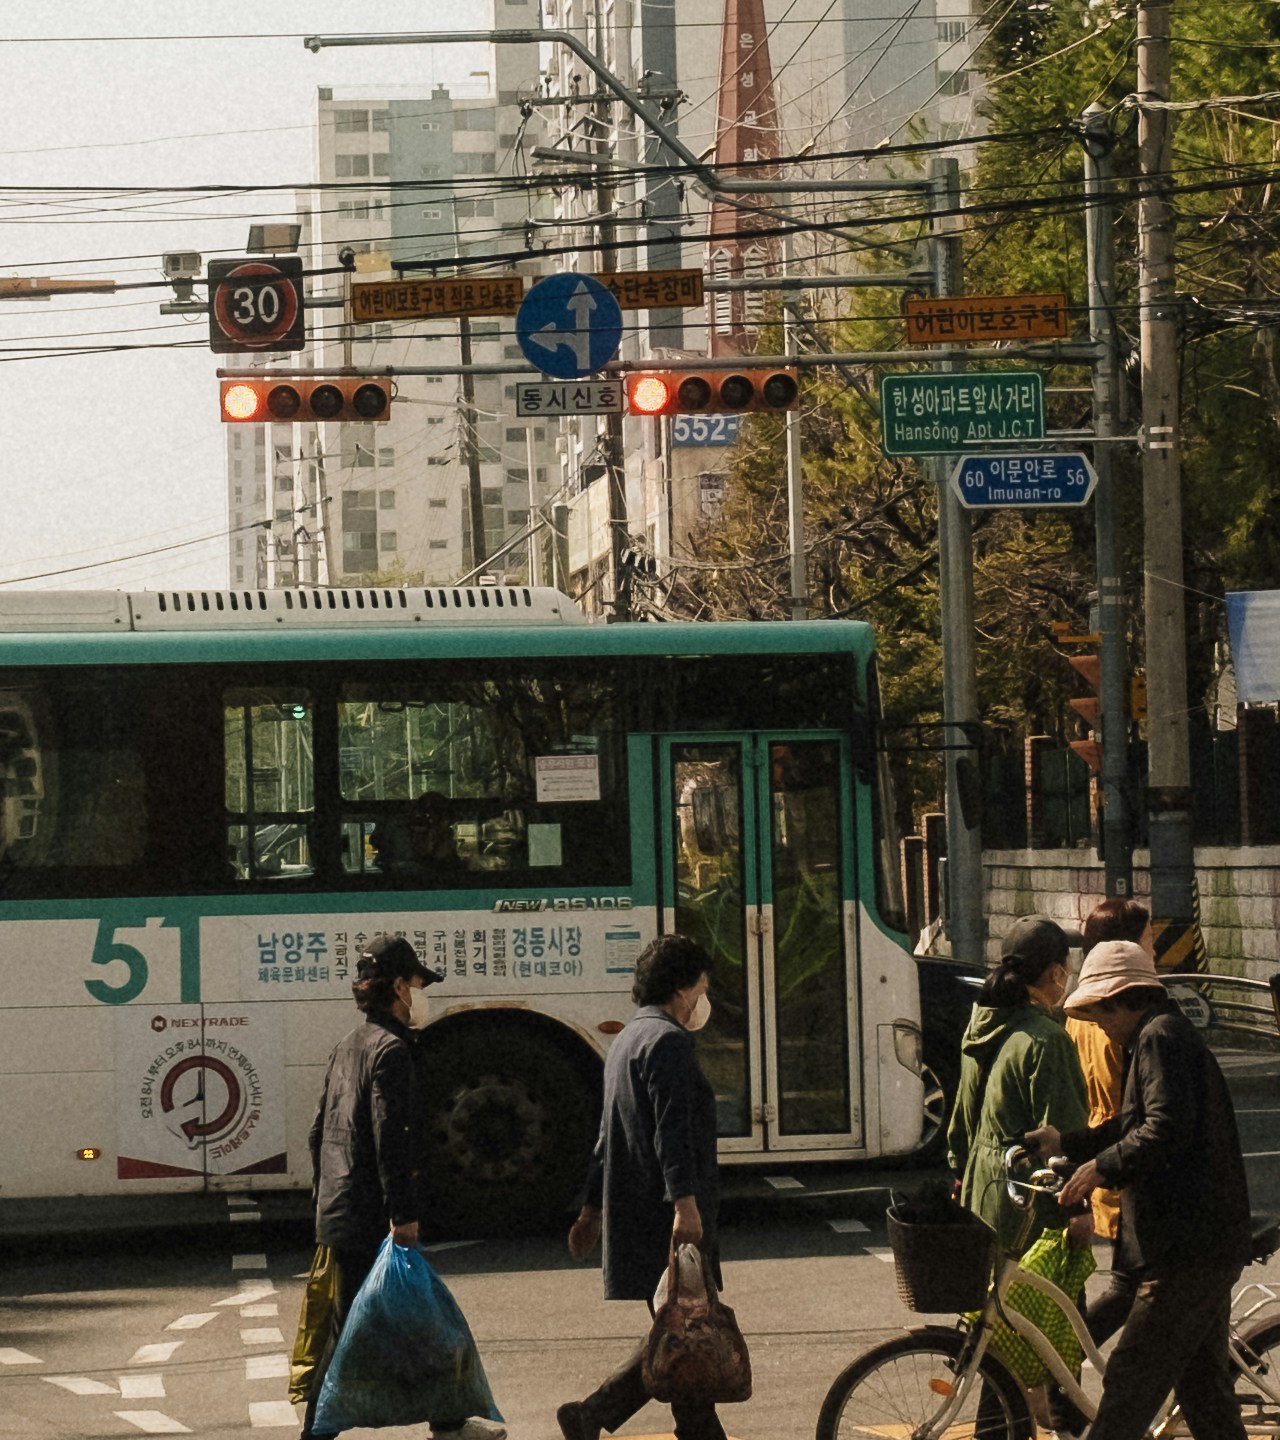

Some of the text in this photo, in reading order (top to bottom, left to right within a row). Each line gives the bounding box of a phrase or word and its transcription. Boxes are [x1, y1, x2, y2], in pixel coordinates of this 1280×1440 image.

[233, 285, 280, 324] 30
[913, 302, 1060, 334] 어린이보호구역
[521, 385, 618, 411] 동시신호
[893, 383, 1036, 417] 한성아파트앞사거리
[965, 470, 984, 488] 60
[989, 459, 1058, 483] 이문안로
[1066, 469, 1085, 486] 56
[988, 486, 1061, 501] Imunan-ro
[500, 900, 541, 911] NEW
[257, 932, 328, 964] 남양주
[472, 929, 487, 977] 회기역
[511, 926, 583, 958] 경동시장
[83, 911, 201, 1005] 51
[511, 959, 584, 978] (현대코아)
[257, 966, 331, 983] 체육문화센터
[170, 1016, 251, 1028] NEXTRADE
